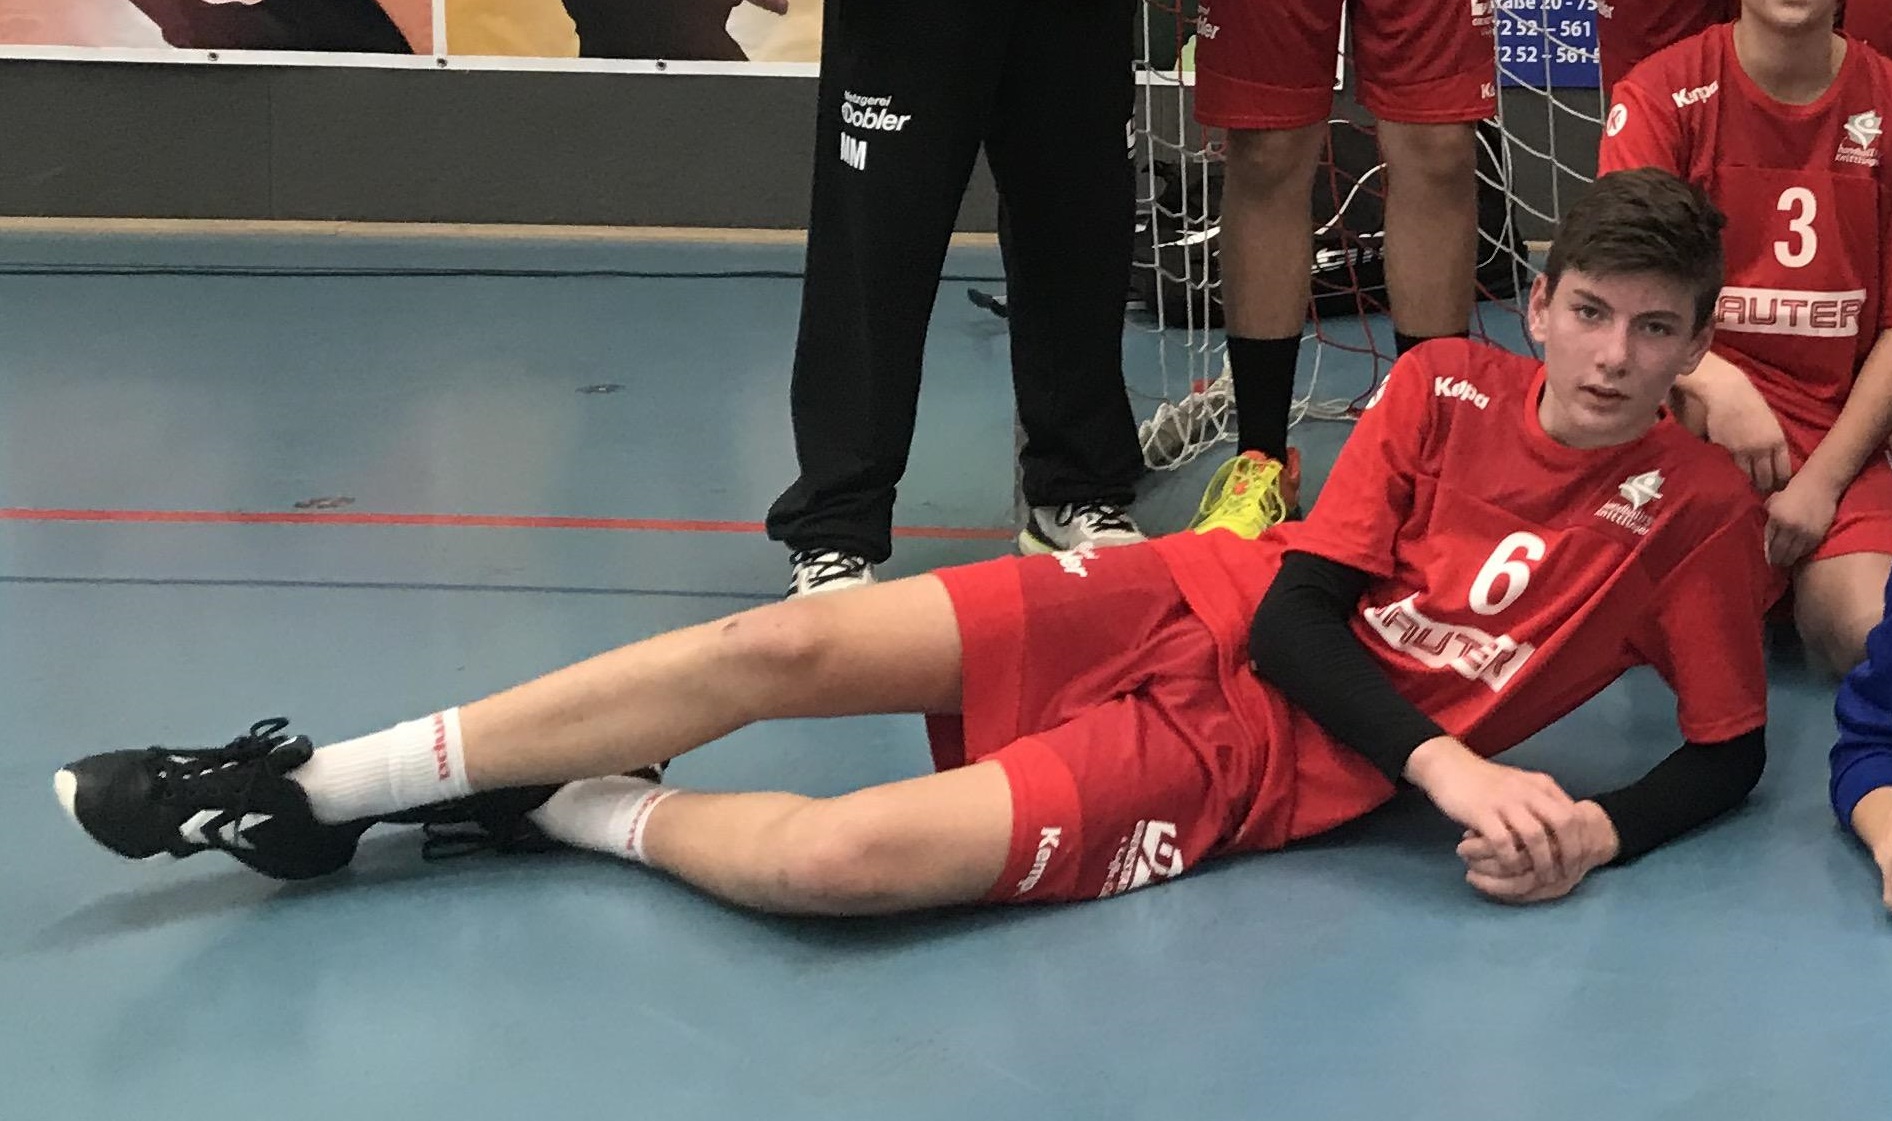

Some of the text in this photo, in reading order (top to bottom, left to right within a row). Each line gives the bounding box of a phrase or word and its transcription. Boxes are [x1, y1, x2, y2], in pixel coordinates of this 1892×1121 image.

[1560, 20, 1591, 37] 561
[1516, 46, 1538, 63] 52
[841, 101, 912, 132] Dobler
[1773, 186, 1818, 268] 3
[1714, 294, 1862, 328] AUTER
[1469, 530, 1546, 616] 6
